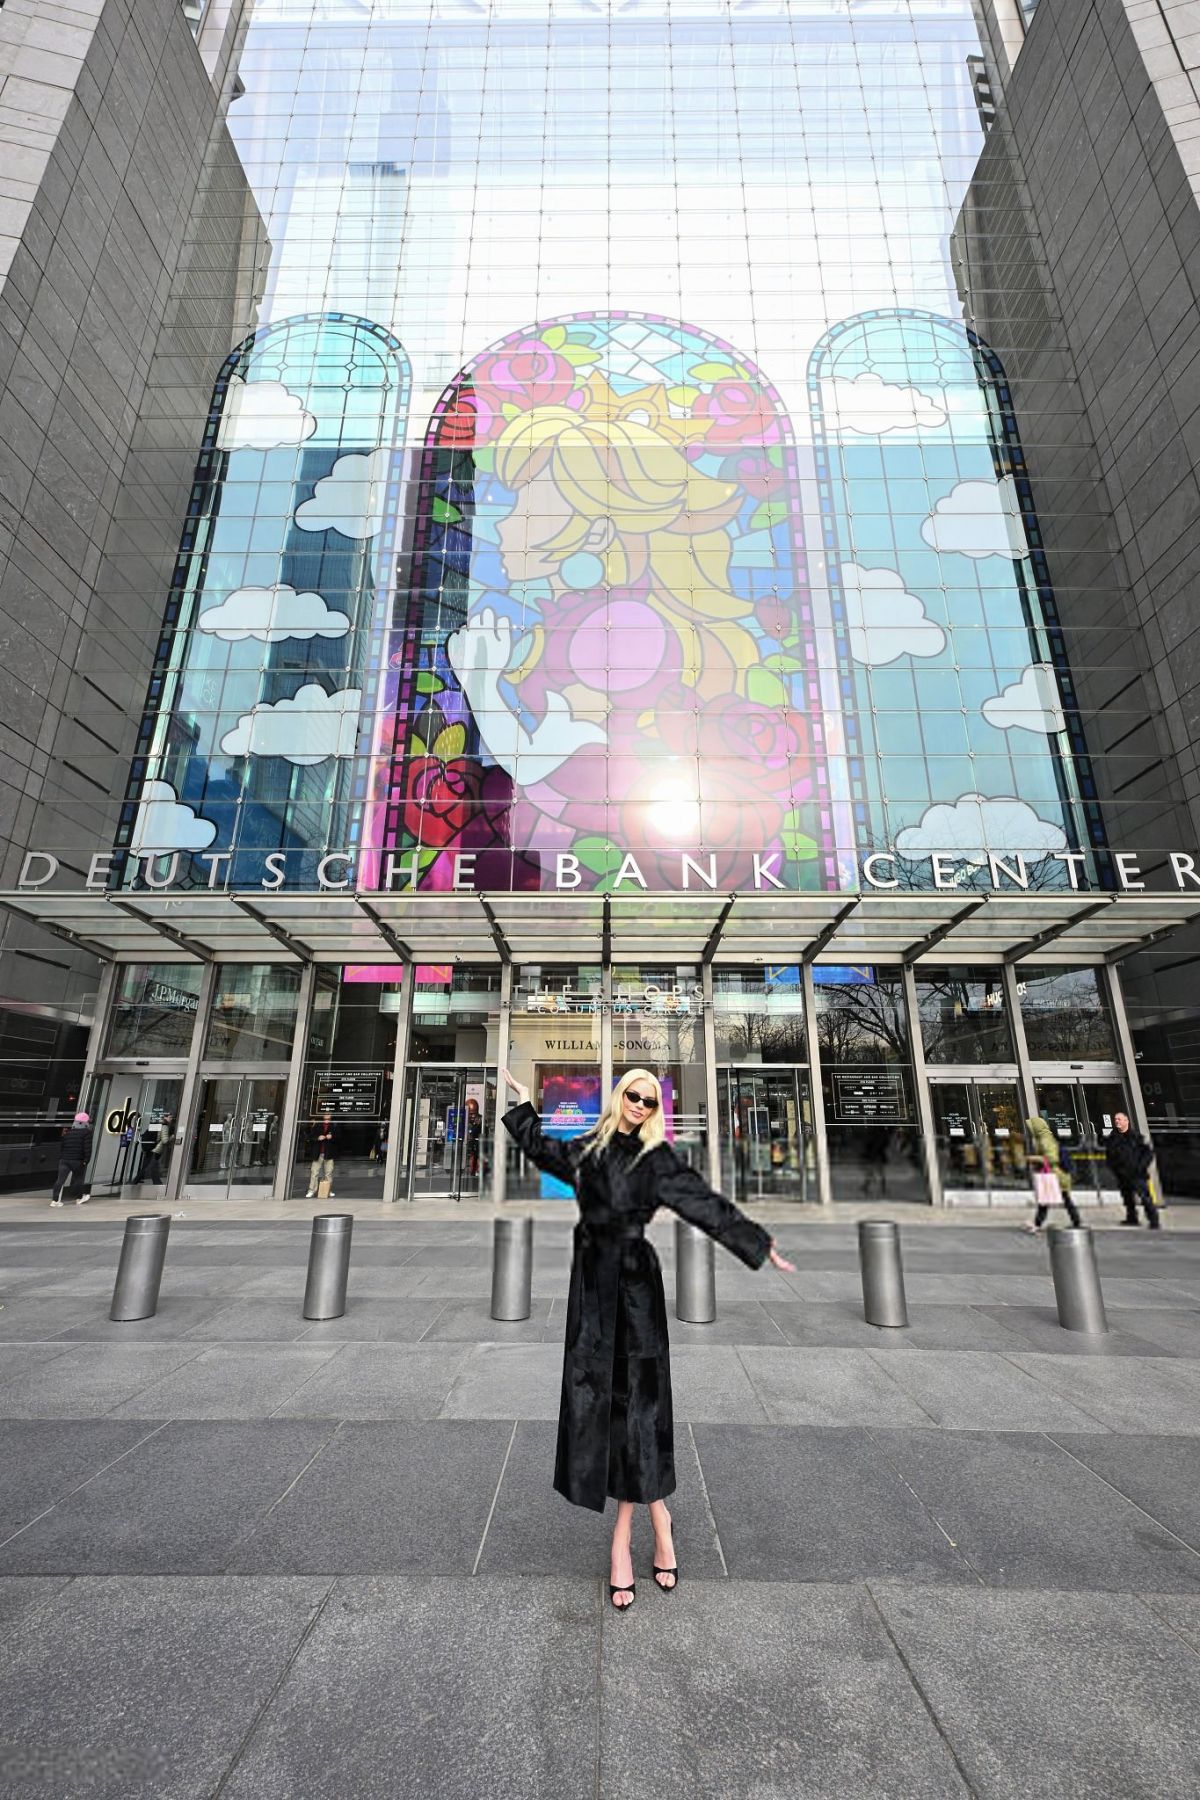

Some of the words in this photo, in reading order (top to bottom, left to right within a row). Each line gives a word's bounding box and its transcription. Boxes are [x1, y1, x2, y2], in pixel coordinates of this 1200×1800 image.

[18, 851, 477, 889] DEUTSCHE
[555, 853, 786, 889] BANK
[863, 853, 1200, 889] CENTER
[512, 984, 572, 1001] THE
[107, 1097, 141, 1133] alo
